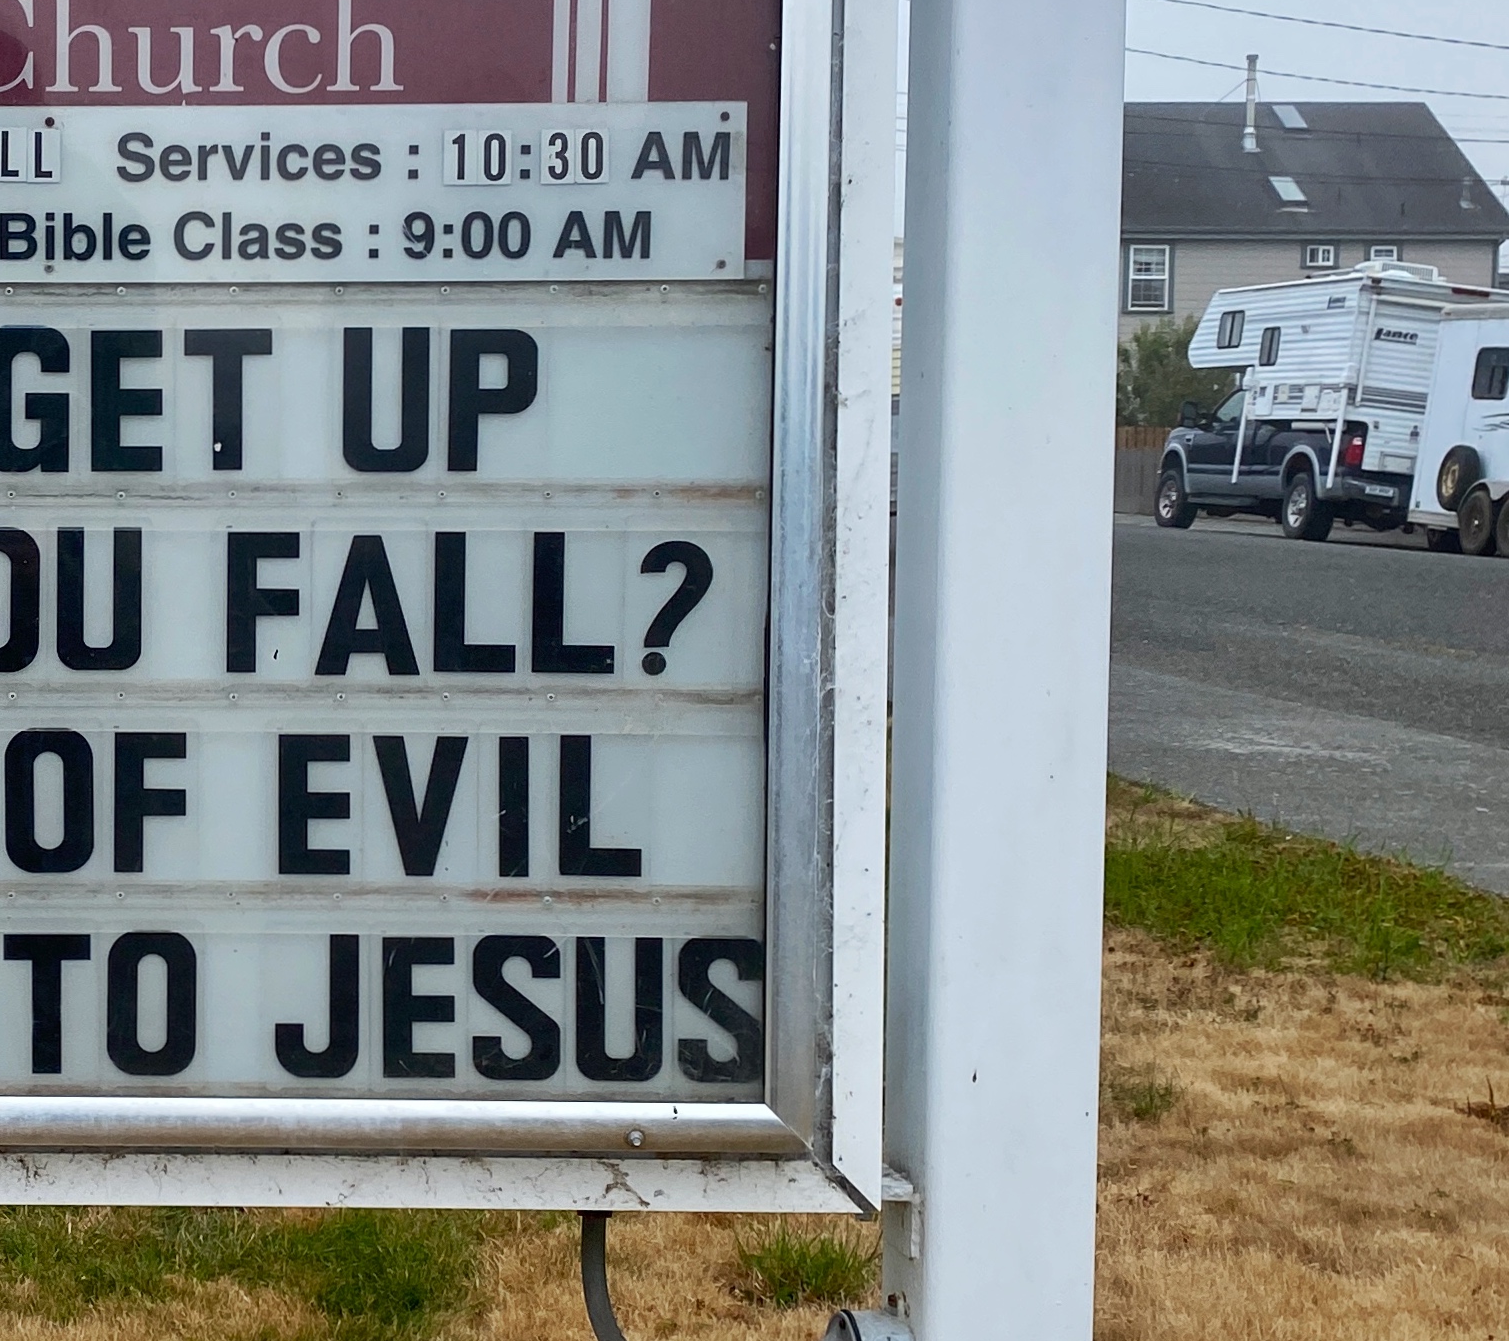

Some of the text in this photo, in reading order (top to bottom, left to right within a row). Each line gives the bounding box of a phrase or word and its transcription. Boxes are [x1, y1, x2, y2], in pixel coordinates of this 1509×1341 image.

[451, 132, 604, 181] 10:30
[631, 131, 731, 180] AM
[403, 210, 530, 260] 9:00
[554, 211, 652, 259] AM
[342, 327, 539, 473] UP
[225, 531, 714, 676] FALL?
[5, 728, 187, 874] OF
[278, 734, 642, 877] EVIL
[3, 931, 197, 1075] TO
[275, 933, 762, 1082] JESUS
